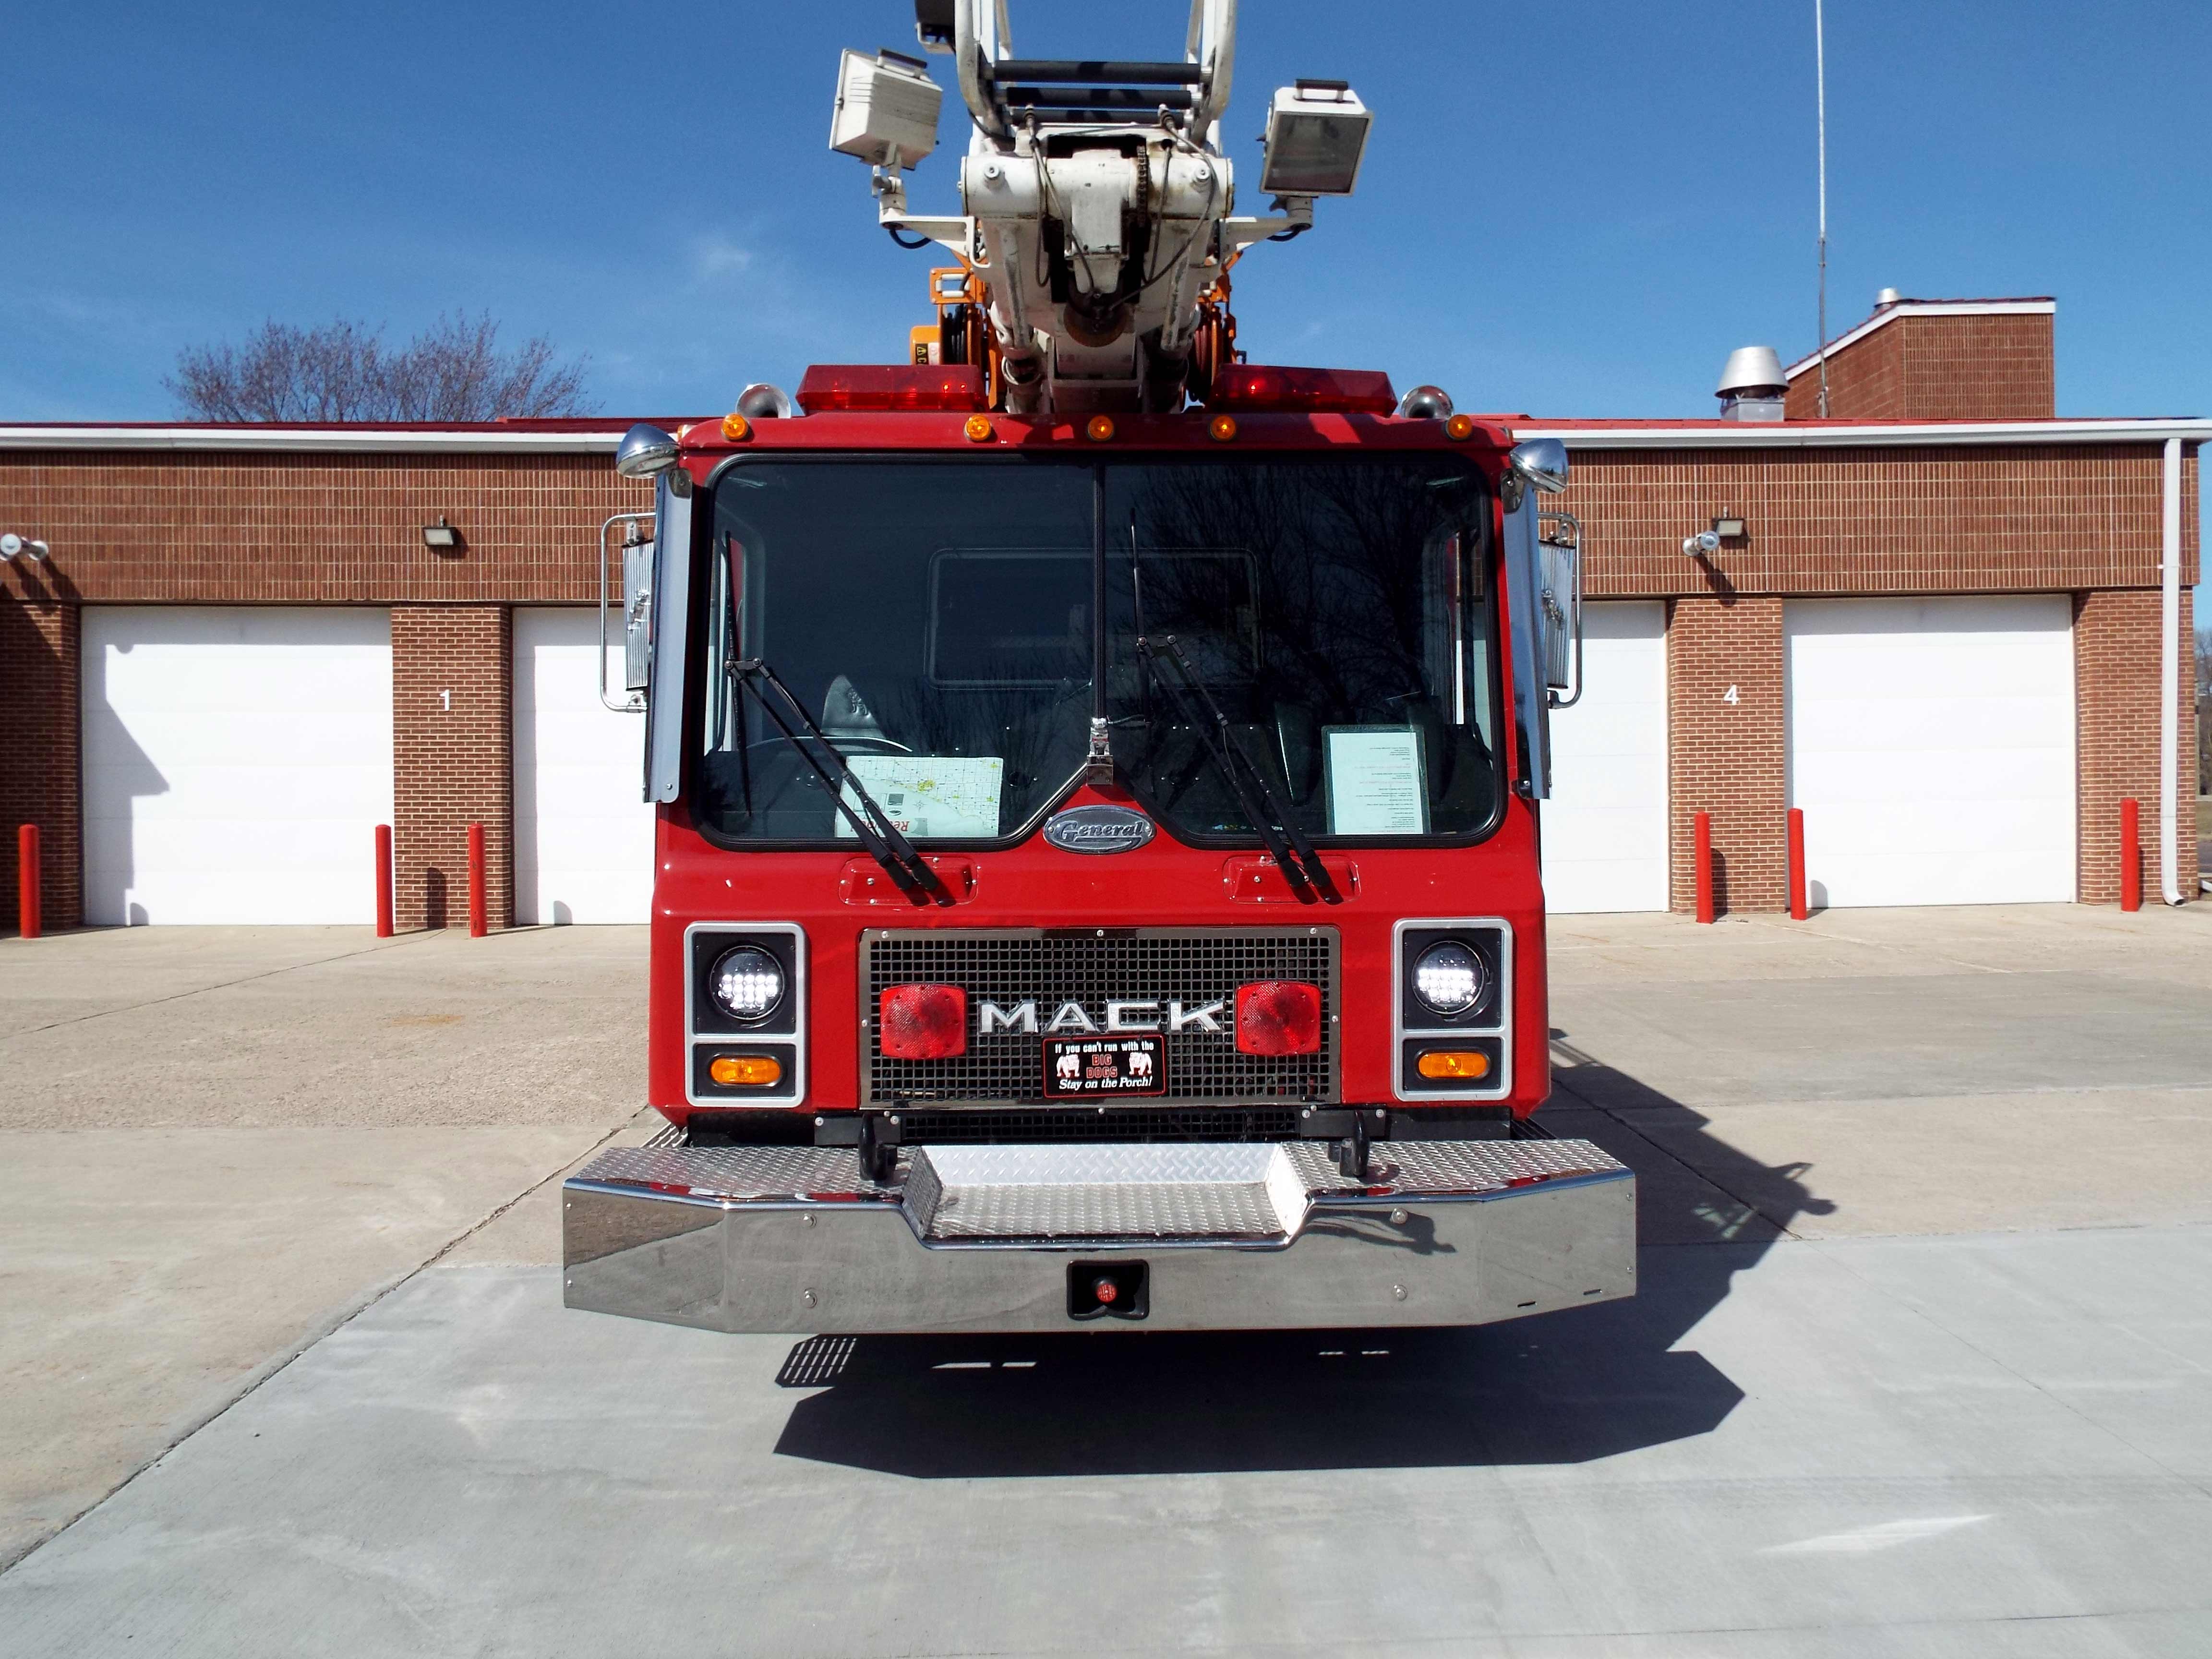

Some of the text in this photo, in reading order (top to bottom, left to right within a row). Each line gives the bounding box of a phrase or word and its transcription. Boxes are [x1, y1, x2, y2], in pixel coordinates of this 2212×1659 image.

[439, 689, 450, 711] 1
[1723, 685, 1740, 706] 4
[1054, 820, 1143, 842] General
[977, 997, 1227, 1033] MACK
[1055, 1041, 1154, 1054] If you can't run with the
[1092, 1054, 1112, 1066] BIG
[1086, 1066, 1118, 1078] DOGS
[1059, 1079, 1082, 1091] Stay
[1101, 1077, 1117, 1088] the
[1119, 1076, 1153, 1088] Porch!
